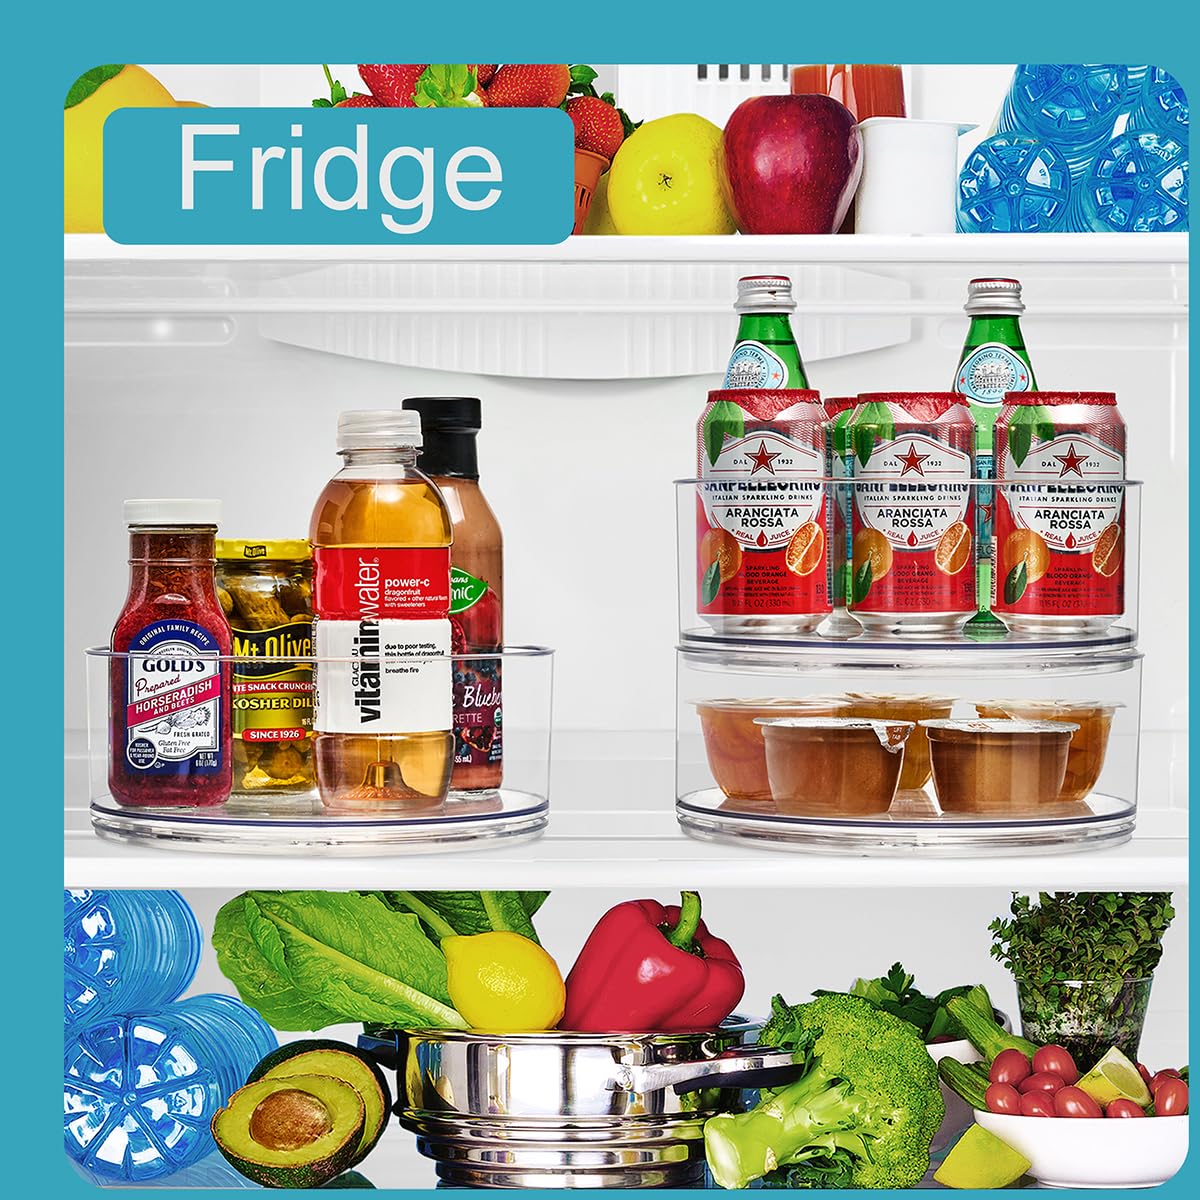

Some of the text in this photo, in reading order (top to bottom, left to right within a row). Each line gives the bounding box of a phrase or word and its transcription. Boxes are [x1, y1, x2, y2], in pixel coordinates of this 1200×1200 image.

[726, 508, 799, 518] ARANCIATA
[877, 508, 948, 518] ARANCIATA
[1034, 510, 1105, 520] ARANCIATA
[740, 518, 784, 528] ROSSA
[892, 518, 934, 528] ROSSA
[1050, 520, 1092, 530] ROSSA
[736, 530, 790, 540] REAL JUICE
[887, 530, 940, 540] REAL JUICE
[1044, 532, 1098, 542] REAL JUICE
[384, 578, 430, 590] power-c
[139, 624, 210, 646] ORIGINAL FAMILY RECIPE
[266, 634, 312, 663] Olive
[142, 659, 206, 673] GOLD'S
[134, 674, 182, 698] Prepared
[248, 682, 277, 692] SNACK
[135, 680, 213, 714] HORSERADISH
[154, 696, 195, 716] AND BEETS
[250, 730, 300, 739] SINCE 1926
